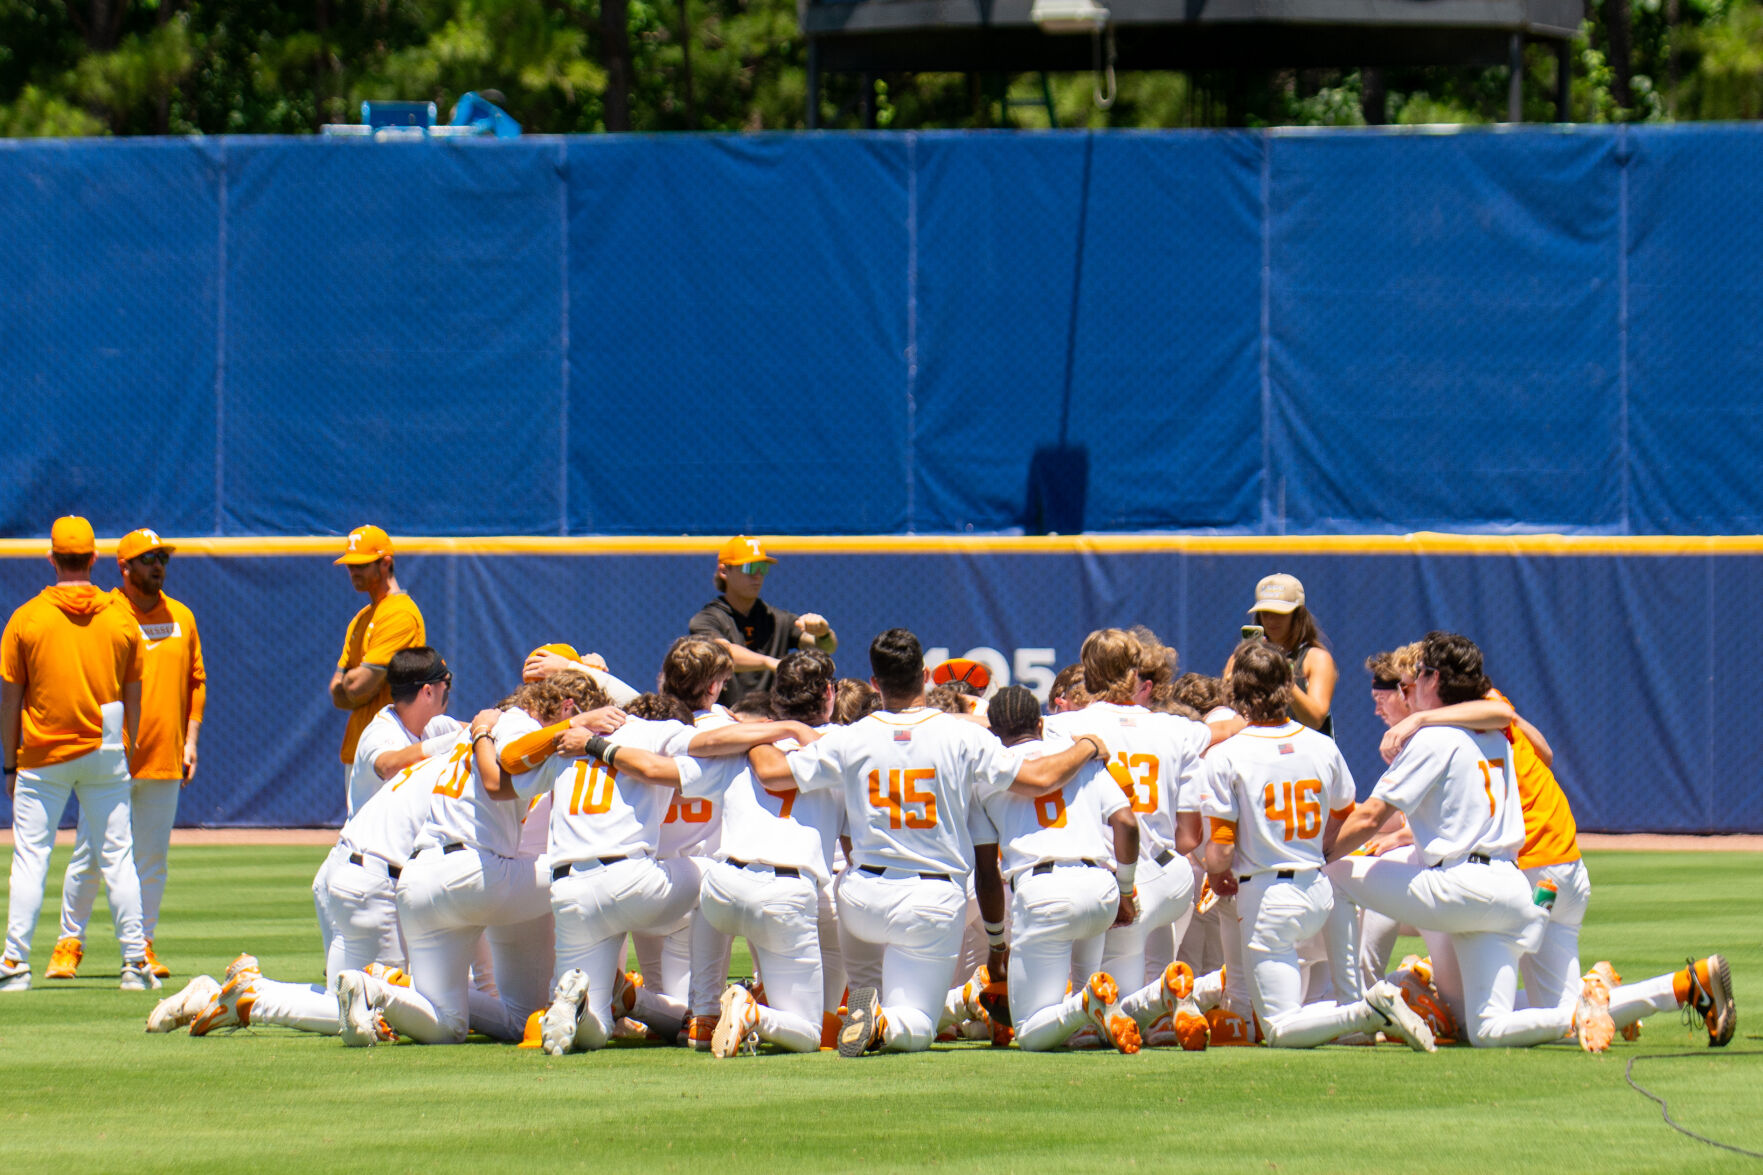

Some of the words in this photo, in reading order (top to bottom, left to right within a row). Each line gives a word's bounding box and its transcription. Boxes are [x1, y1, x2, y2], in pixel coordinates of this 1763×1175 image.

[142, 529, 160, 545] T
[348, 534, 362, 551] T
[745, 539, 761, 556] T
[744, 626, 755, 637] T
[569, 759, 618, 815] 10
[868, 768, 938, 830] 45
[1264, 779, 1322, 842] 46
[1225, 1018, 1242, 1038] T
